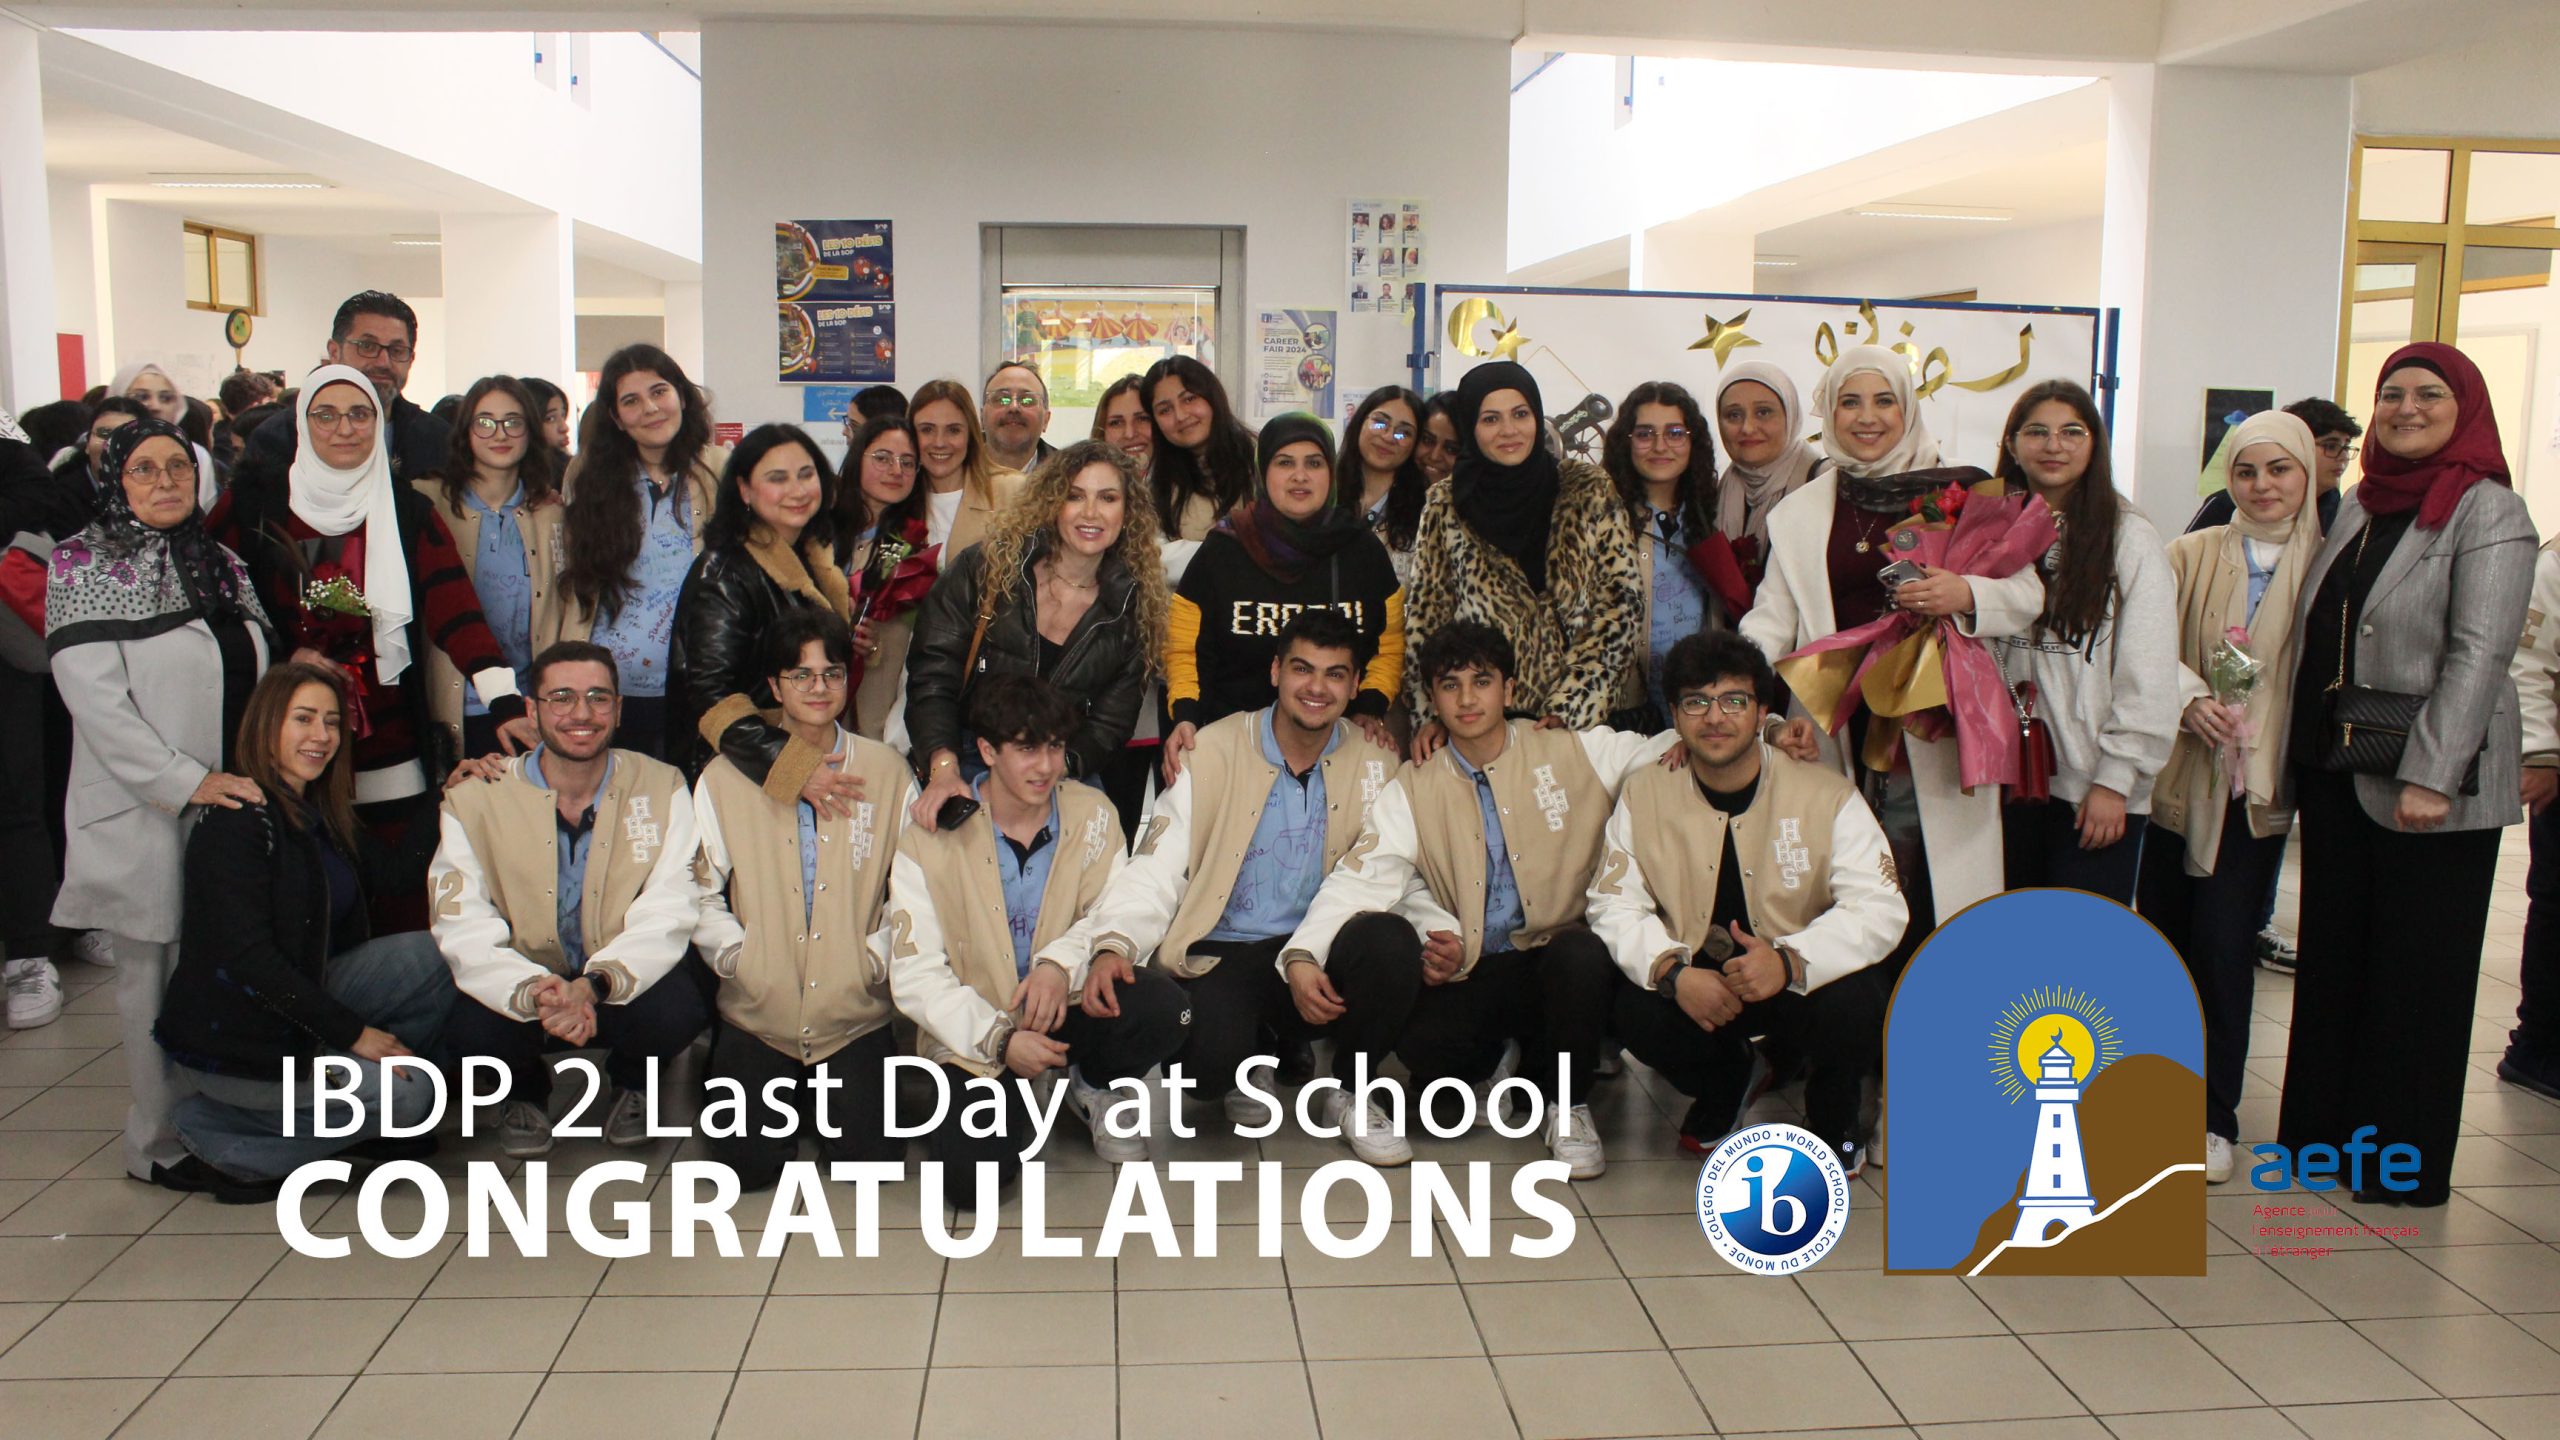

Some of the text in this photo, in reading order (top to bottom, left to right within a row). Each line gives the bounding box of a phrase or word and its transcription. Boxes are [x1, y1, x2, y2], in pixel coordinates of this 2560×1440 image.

[822, 233, 883, 250] LES 10 DÉFIS
[817, 309, 833, 320] LES
[834, 307, 848, 319] 10
[1264, 337, 1299, 345] CAREER
[1264, 345, 1284, 353] FAIR
[1230, 600, 1365, 636] ERR!
